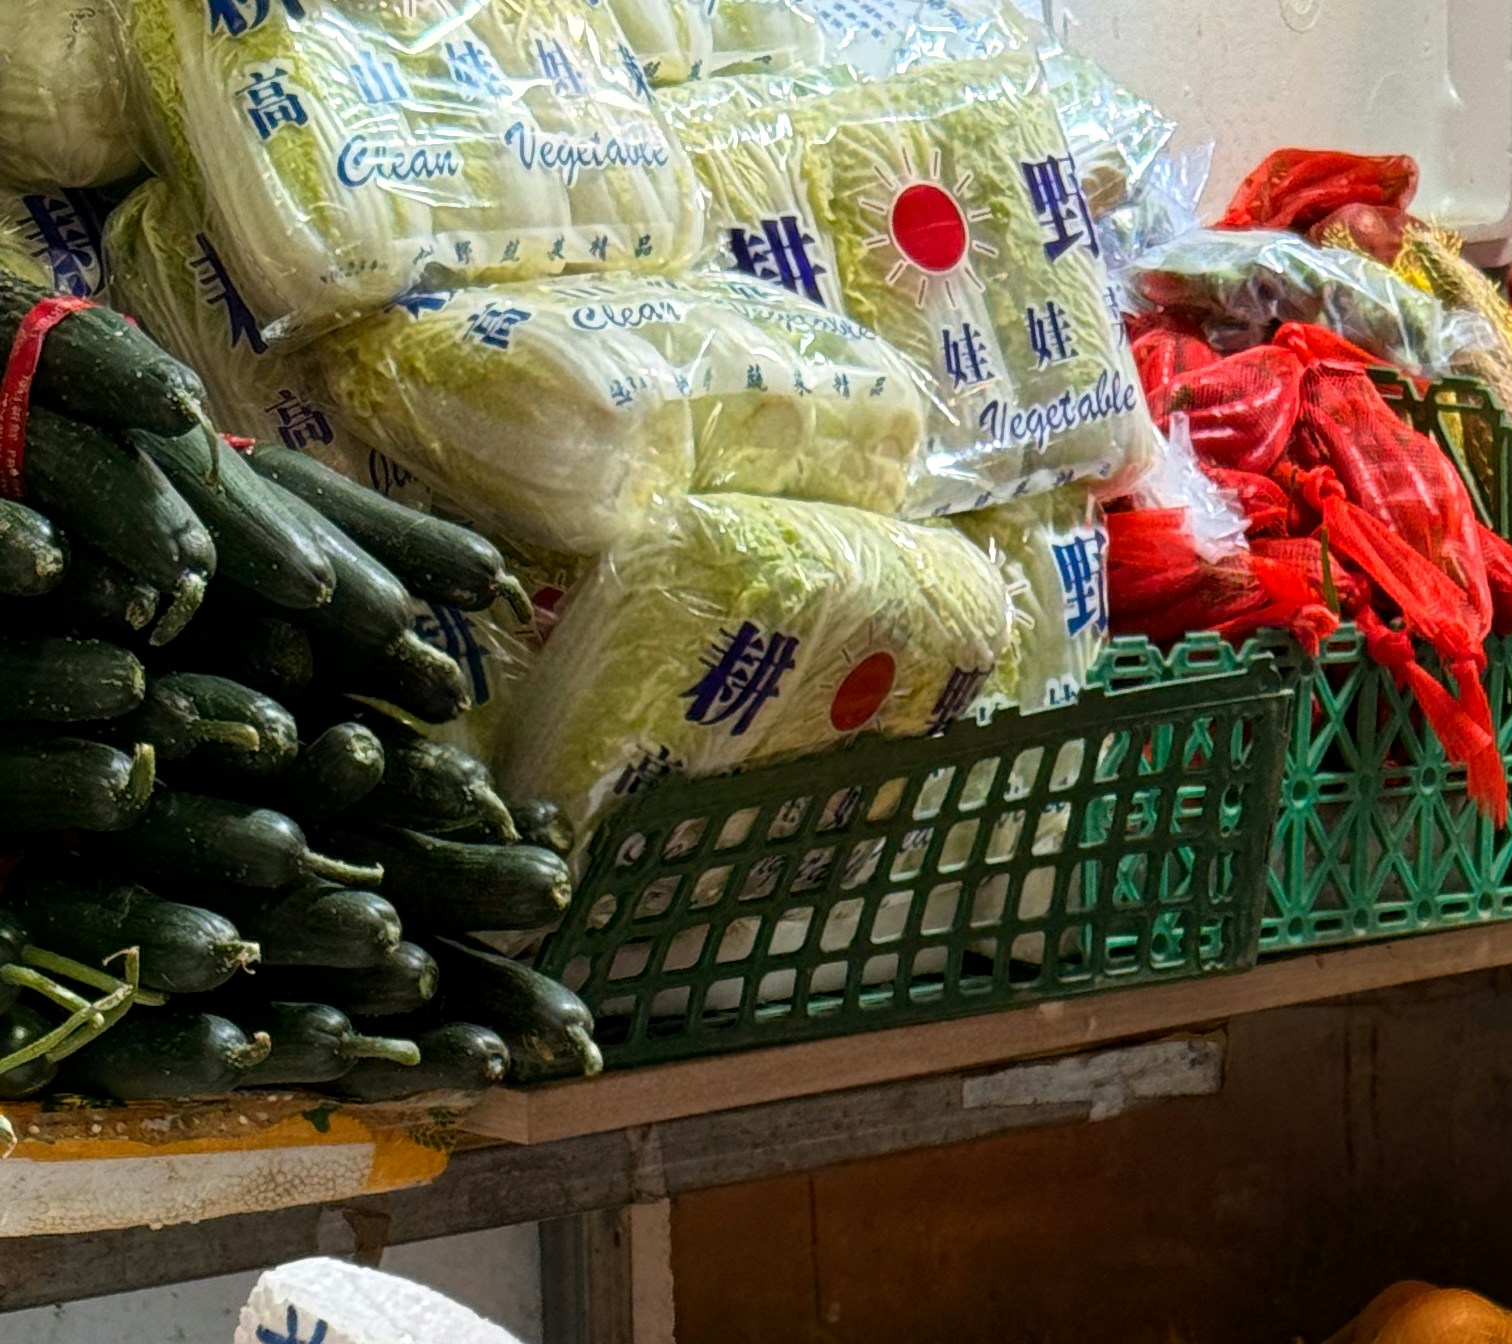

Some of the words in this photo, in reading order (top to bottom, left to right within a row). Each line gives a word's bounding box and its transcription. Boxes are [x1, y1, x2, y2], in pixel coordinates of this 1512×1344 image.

[336, 134, 459, 188] Clean
[1020, 152, 1102, 264] 野
[571, 300, 683, 331] Clean
[978, 374, 1138, 453] Vegetable
